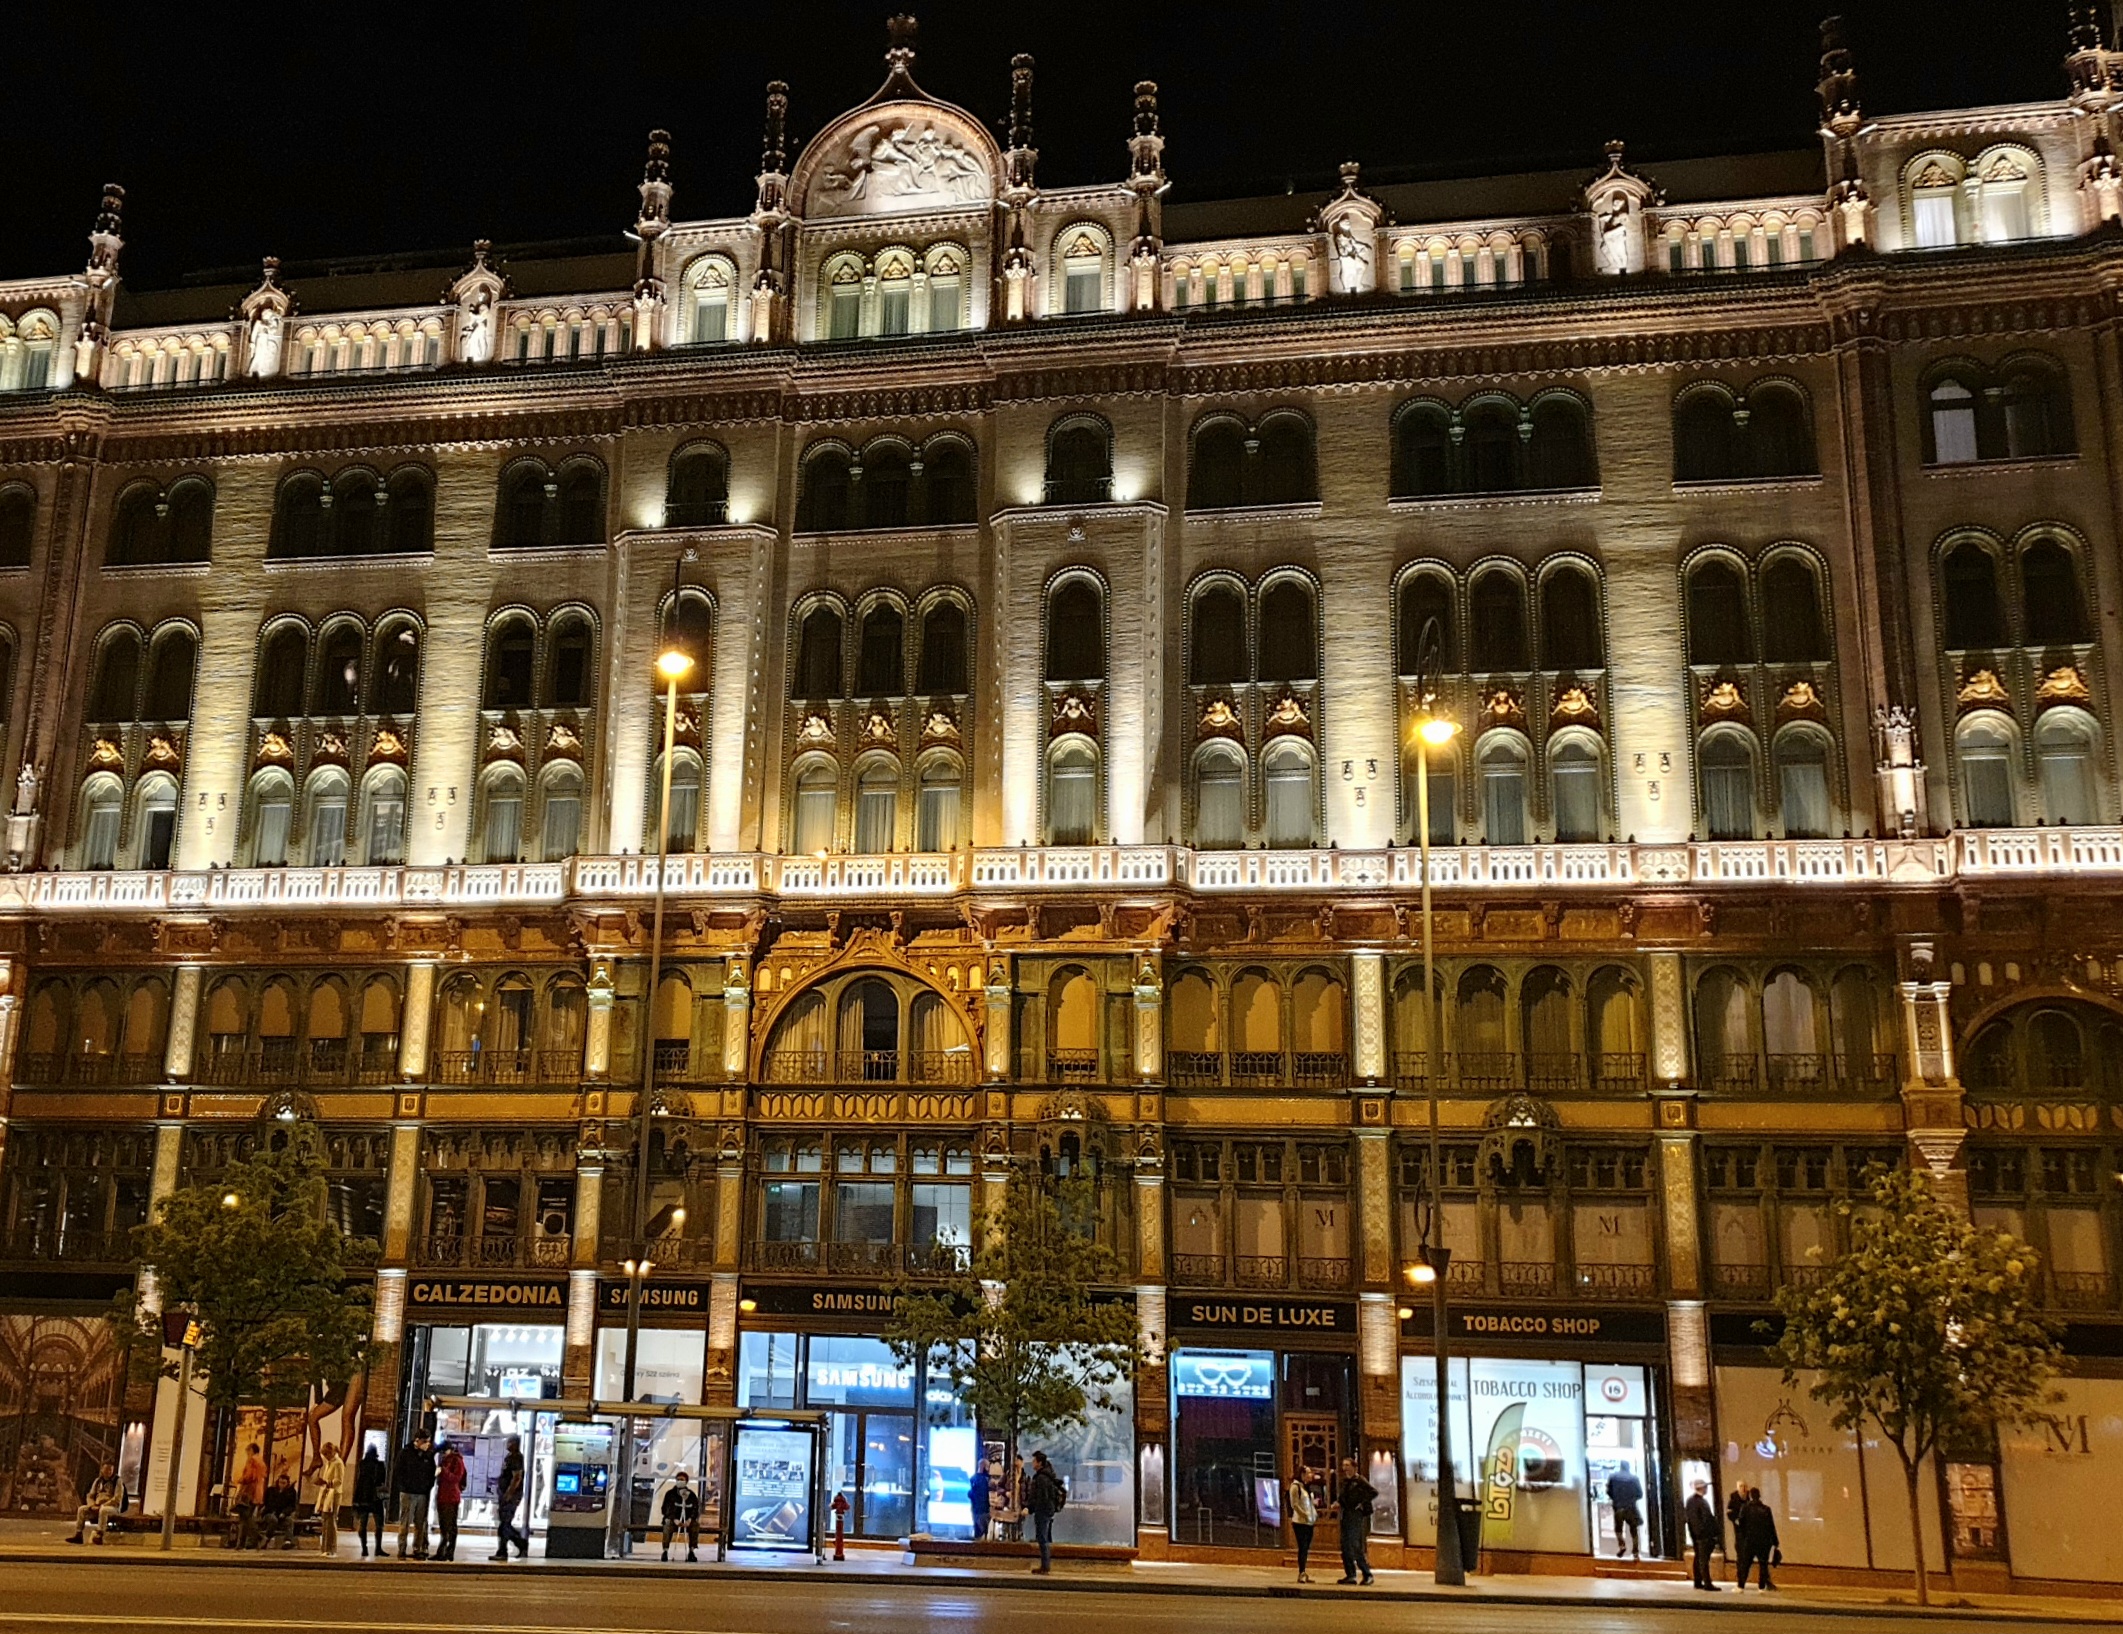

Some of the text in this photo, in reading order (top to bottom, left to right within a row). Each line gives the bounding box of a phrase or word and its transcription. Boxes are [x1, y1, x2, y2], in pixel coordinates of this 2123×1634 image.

[413, 1284, 562, 1305] CALZEDONIA
[1191, 1305, 1336, 1326] SUN DE LUXE
[1463, 1315, 1600, 1334] TOBACCO SHOP
[817, 1369, 909, 1388] SAMSUNG
[1473, 1379, 1582, 1399] TOBACCO SHOP
[1608, 1385, 1621, 1395] 18
